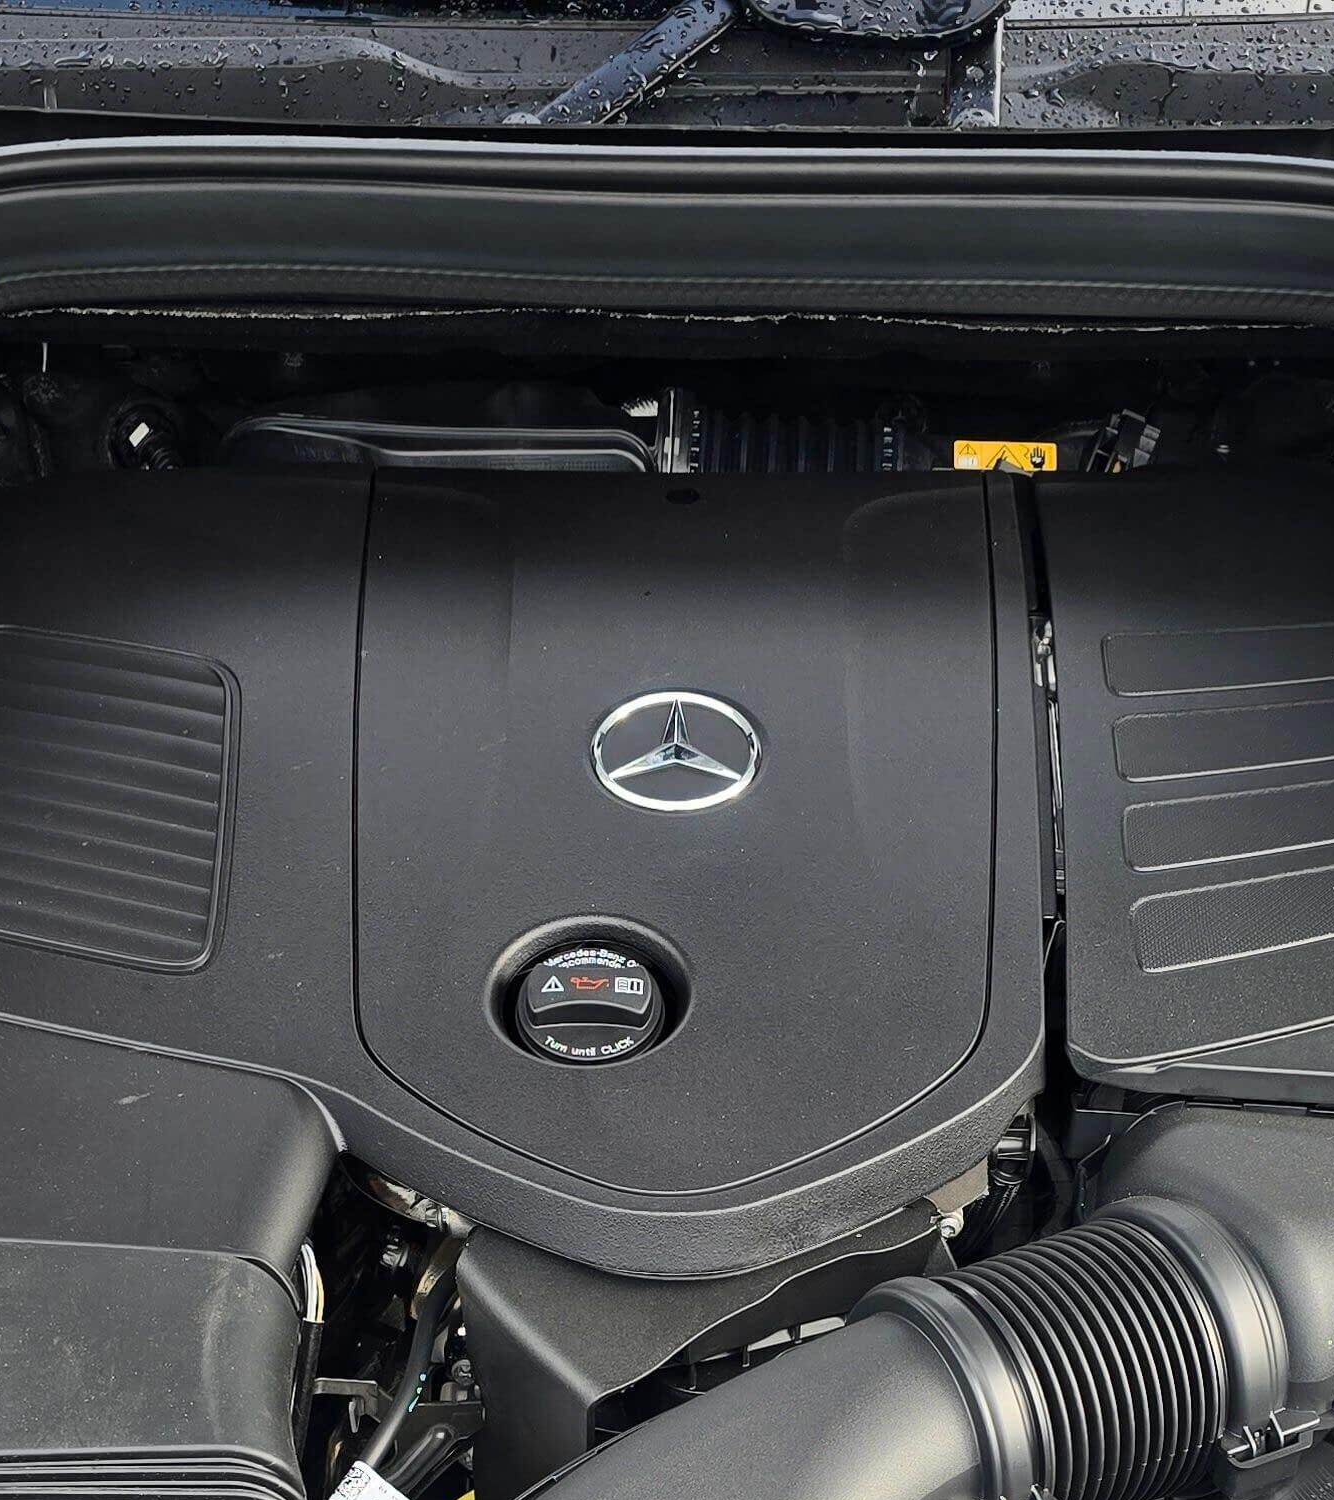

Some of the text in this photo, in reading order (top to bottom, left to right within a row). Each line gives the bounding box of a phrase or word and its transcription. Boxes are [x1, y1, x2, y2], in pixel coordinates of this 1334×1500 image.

[544, 1035, 635, 1057] Turn until CLICK
